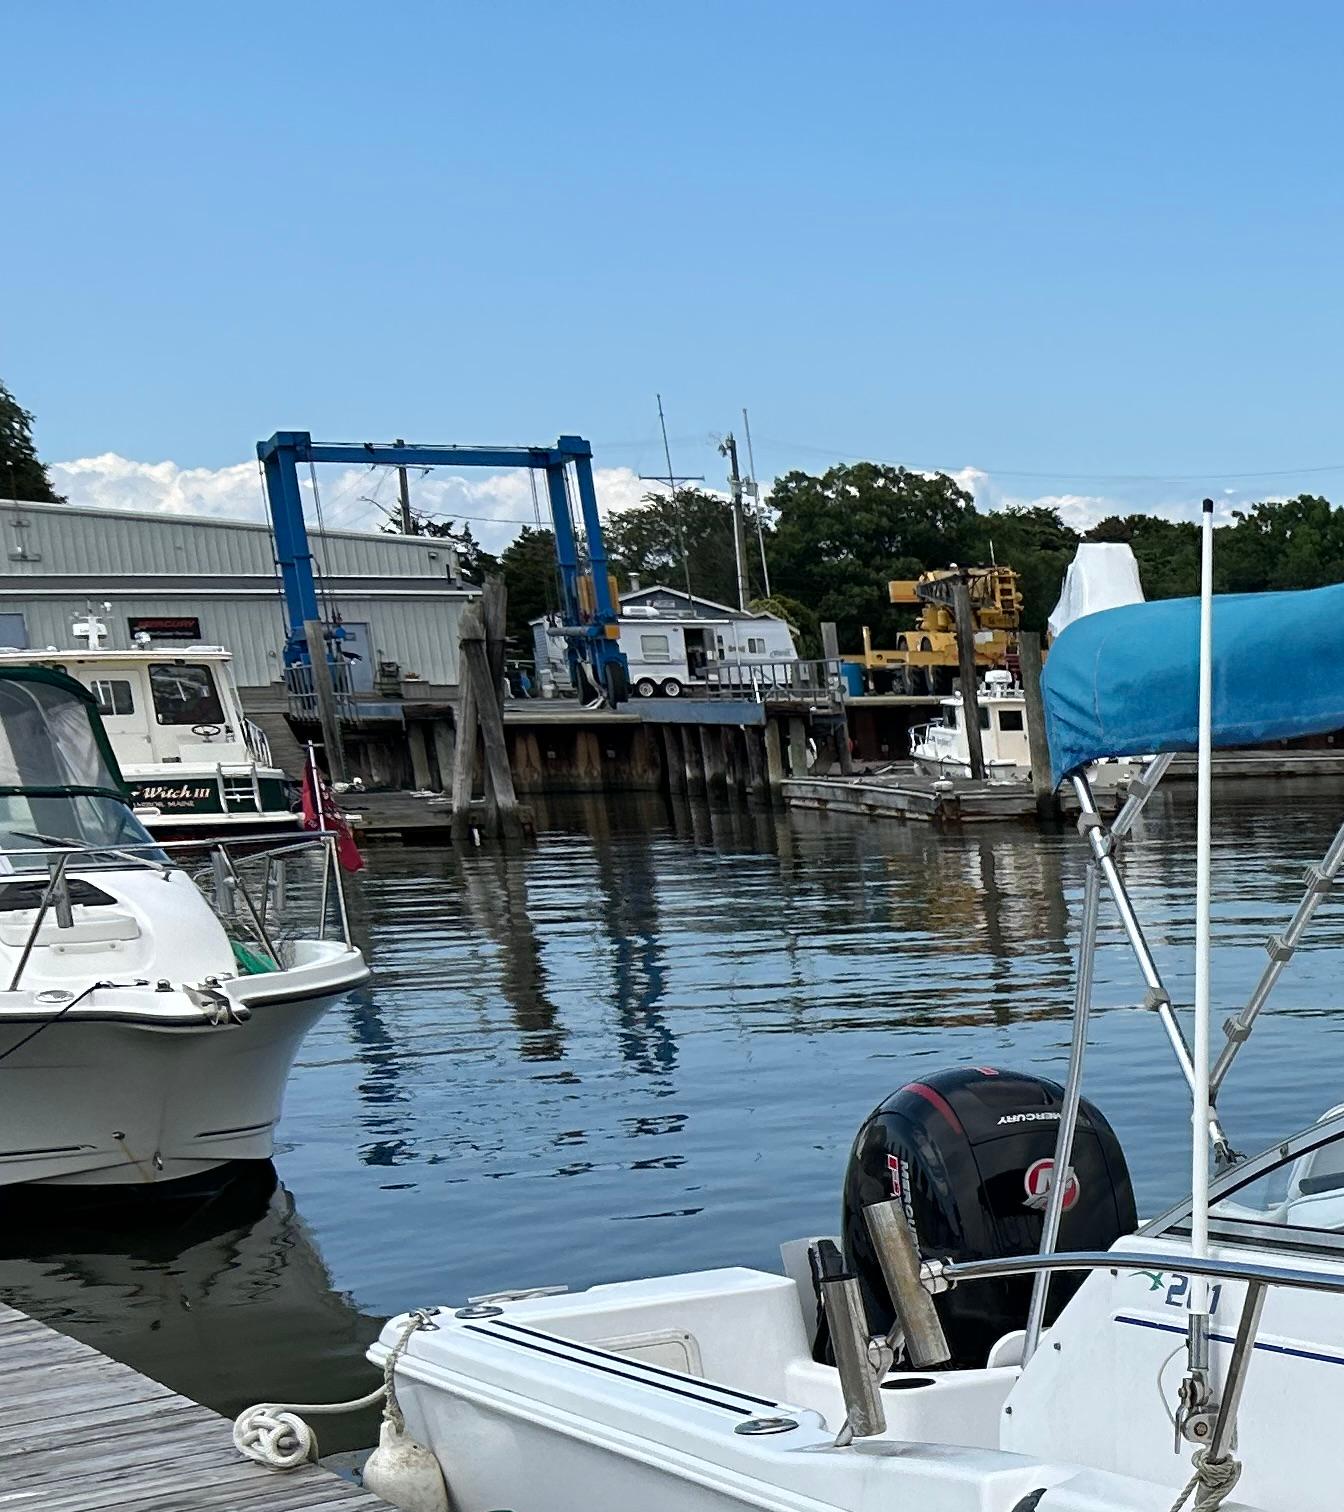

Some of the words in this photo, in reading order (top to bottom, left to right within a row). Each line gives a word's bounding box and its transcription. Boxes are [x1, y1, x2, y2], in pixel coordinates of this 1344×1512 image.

[143, 784, 192, 799] Witch
[193, 788, 210, 798] III
[997, 1112, 1062, 1126] MERCURY
[1165, 1273, 1222, 1314] 21
